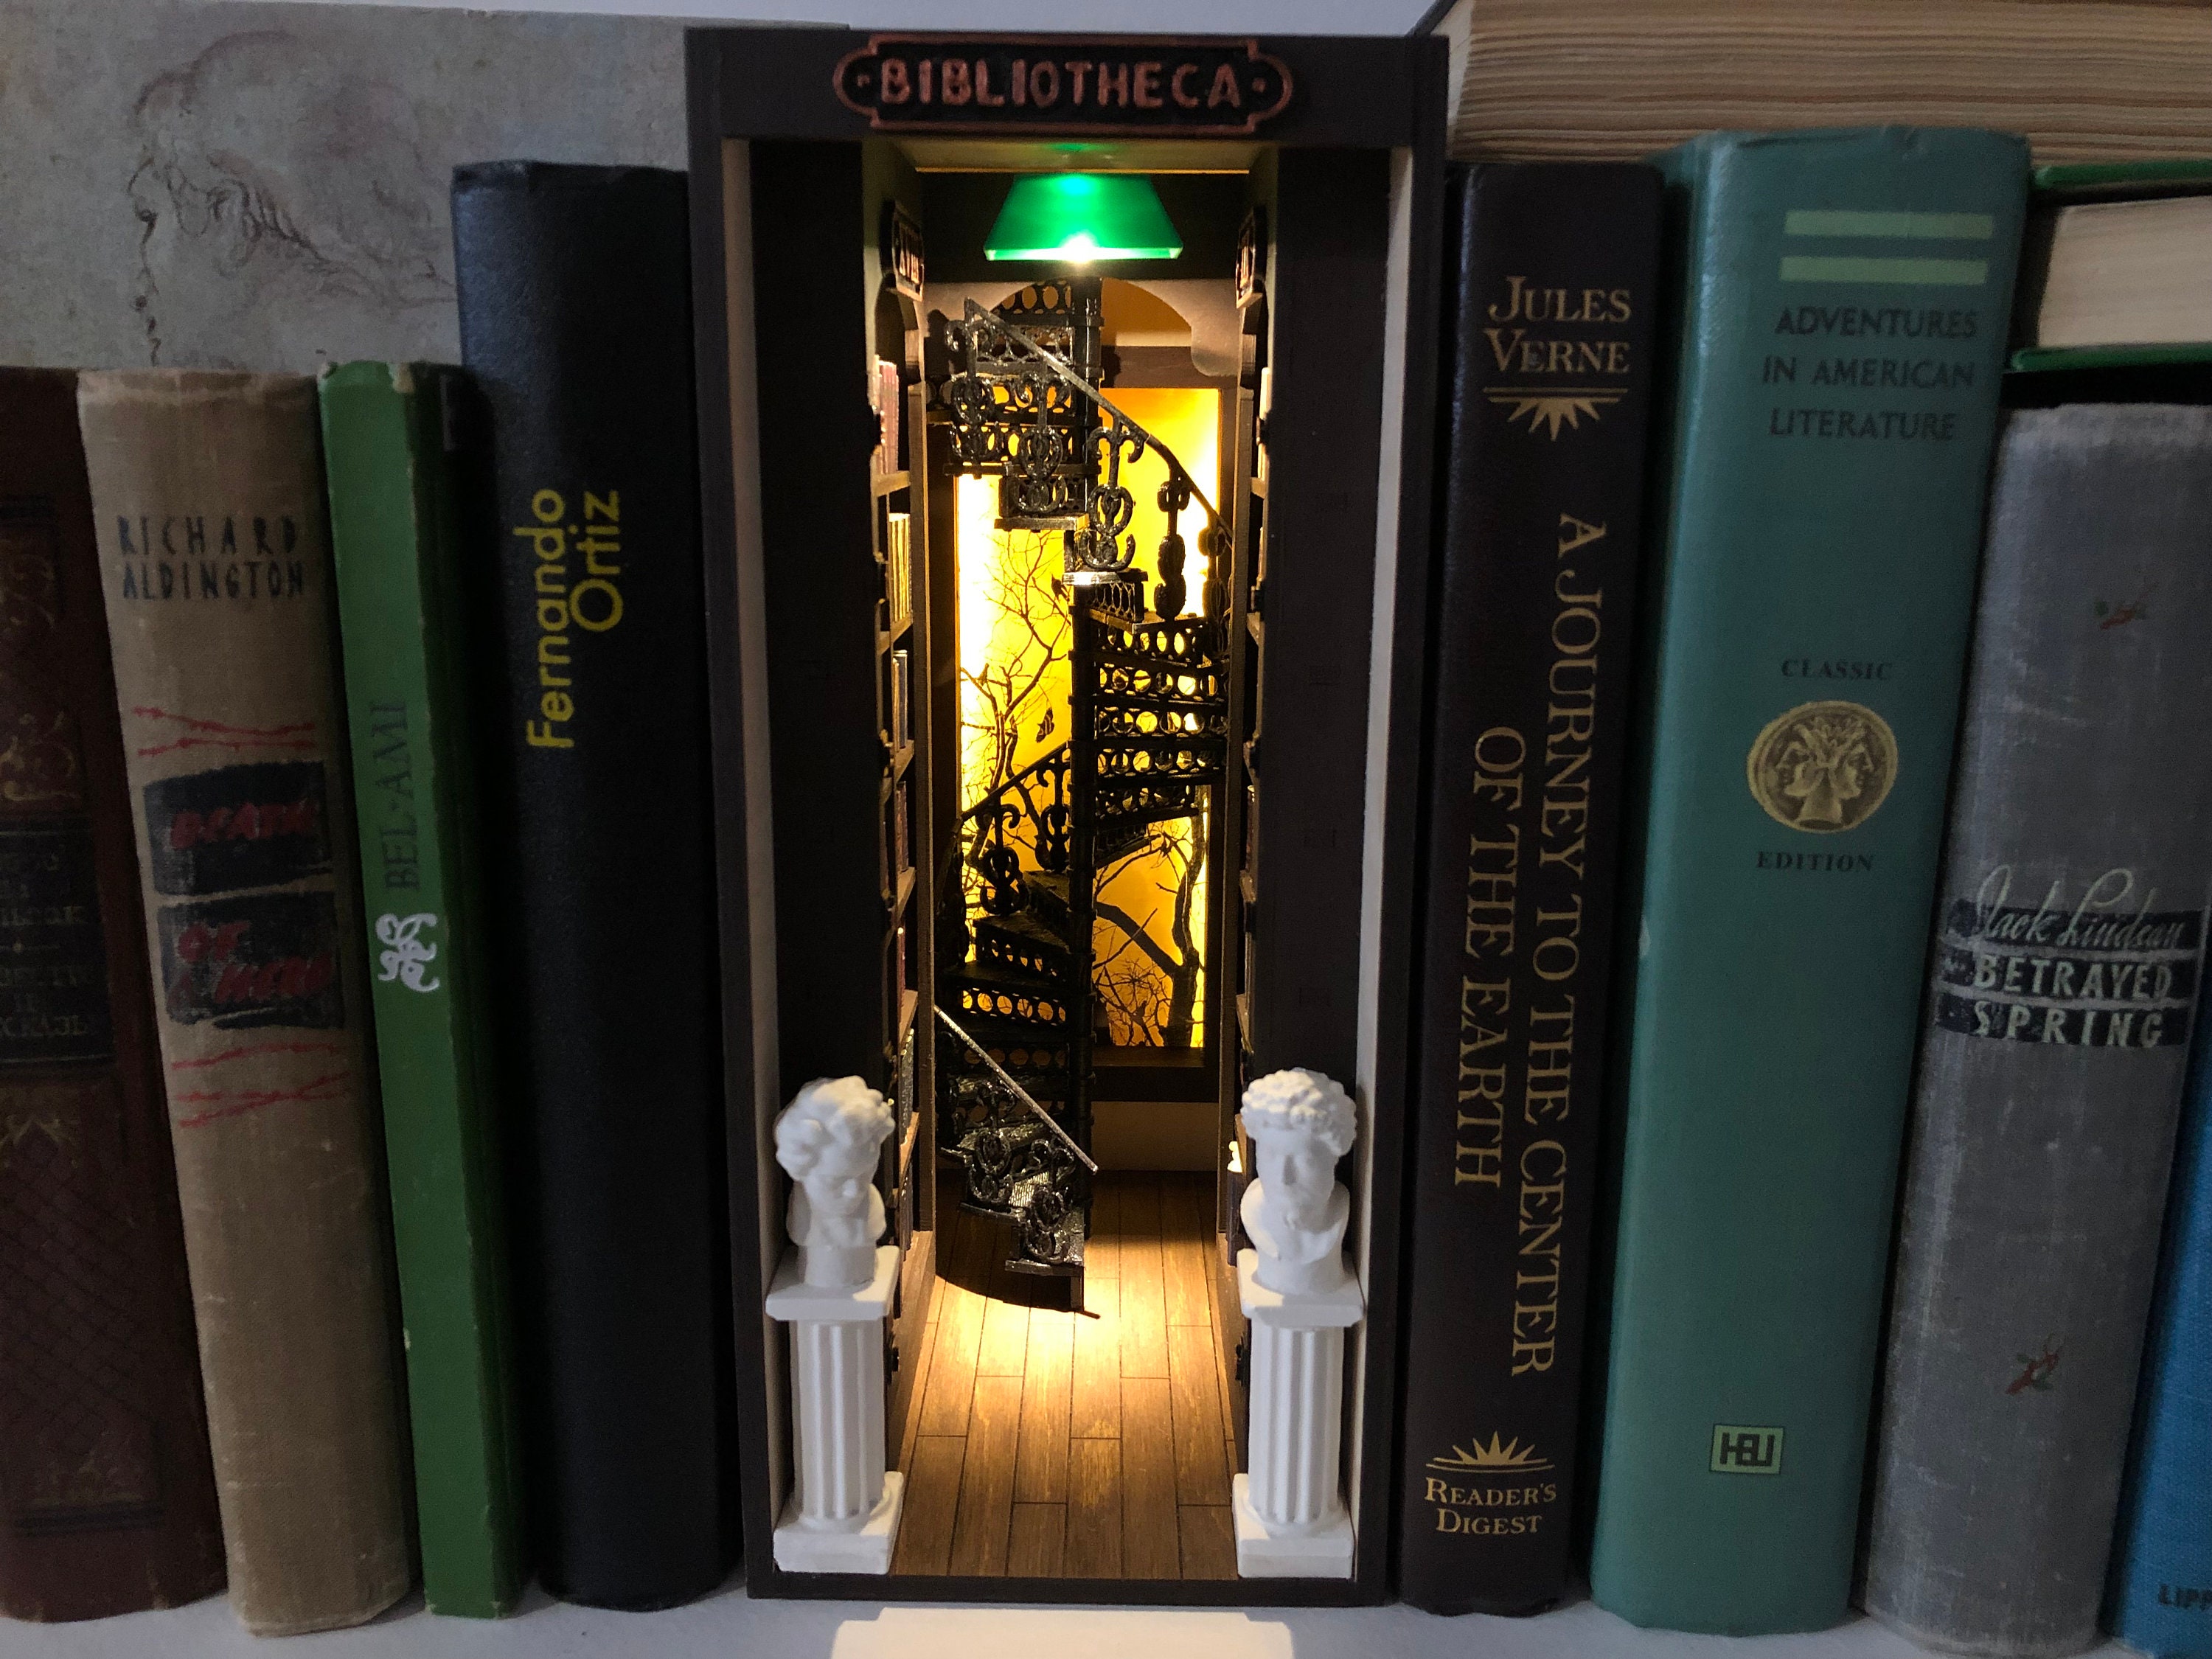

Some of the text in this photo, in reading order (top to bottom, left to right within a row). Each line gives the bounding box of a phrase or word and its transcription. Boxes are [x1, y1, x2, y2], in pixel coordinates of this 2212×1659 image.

[880, 58, 1242, 108] BIBLIOTHECA
[1488, 276, 1631, 324] JULES
[1774, 306, 1980, 339] ADVENTURES
[1483, 328, 1630, 373] VERNE
[1763, 355, 1976, 389] IN AMERICAN
[1770, 408, 1956, 441] LITERATURE
[117, 515, 296, 554] RICHARD
[123, 560, 304, 599] ALDINGTON
[567, 489, 625, 632] Ortiz
[512, 488, 575, 748] Fernando
[1781, 658, 1893, 681] CLASSIC
[369, 701, 420, 888] BEL-AMI
[1756, 850, 1875, 872] EDITION
[1976, 865, 2059, 942] Jack
[1454, 726, 1526, 1188] OF THE EARTH
[1511, 512, 1607, 1377] A JOURNEY TO THE CENTER
[1972, 953, 2173, 1001] BETRAYED
[1972, 1000, 2163, 1048] SPRING
[1424, 1477, 1557, 1506] READER'S
[1436, 1508, 1543, 1534] DIGEST
